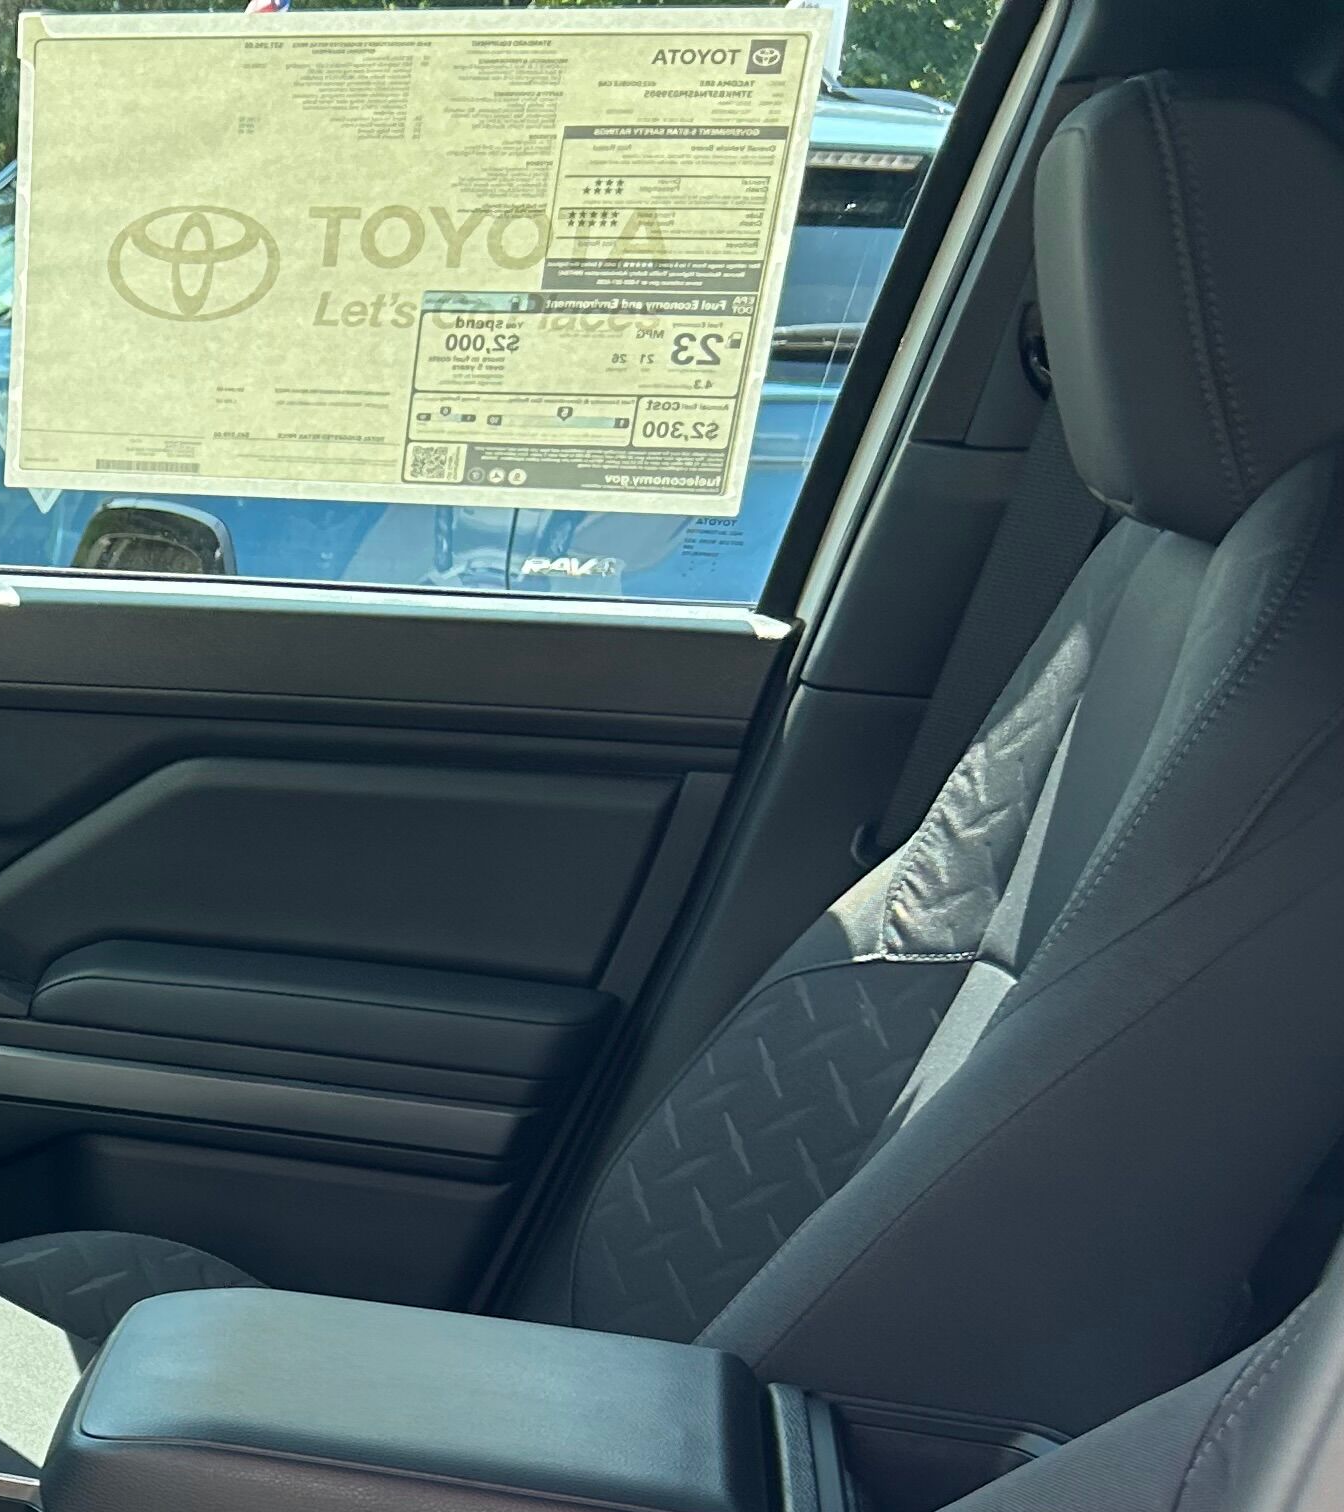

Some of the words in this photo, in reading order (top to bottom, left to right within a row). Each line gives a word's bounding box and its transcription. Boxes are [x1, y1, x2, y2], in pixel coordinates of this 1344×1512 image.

[309, 204, 670, 271] TOYOTA
[311, 289, 417, 330] Let's
[520, 556, 617, 579] RAV4
